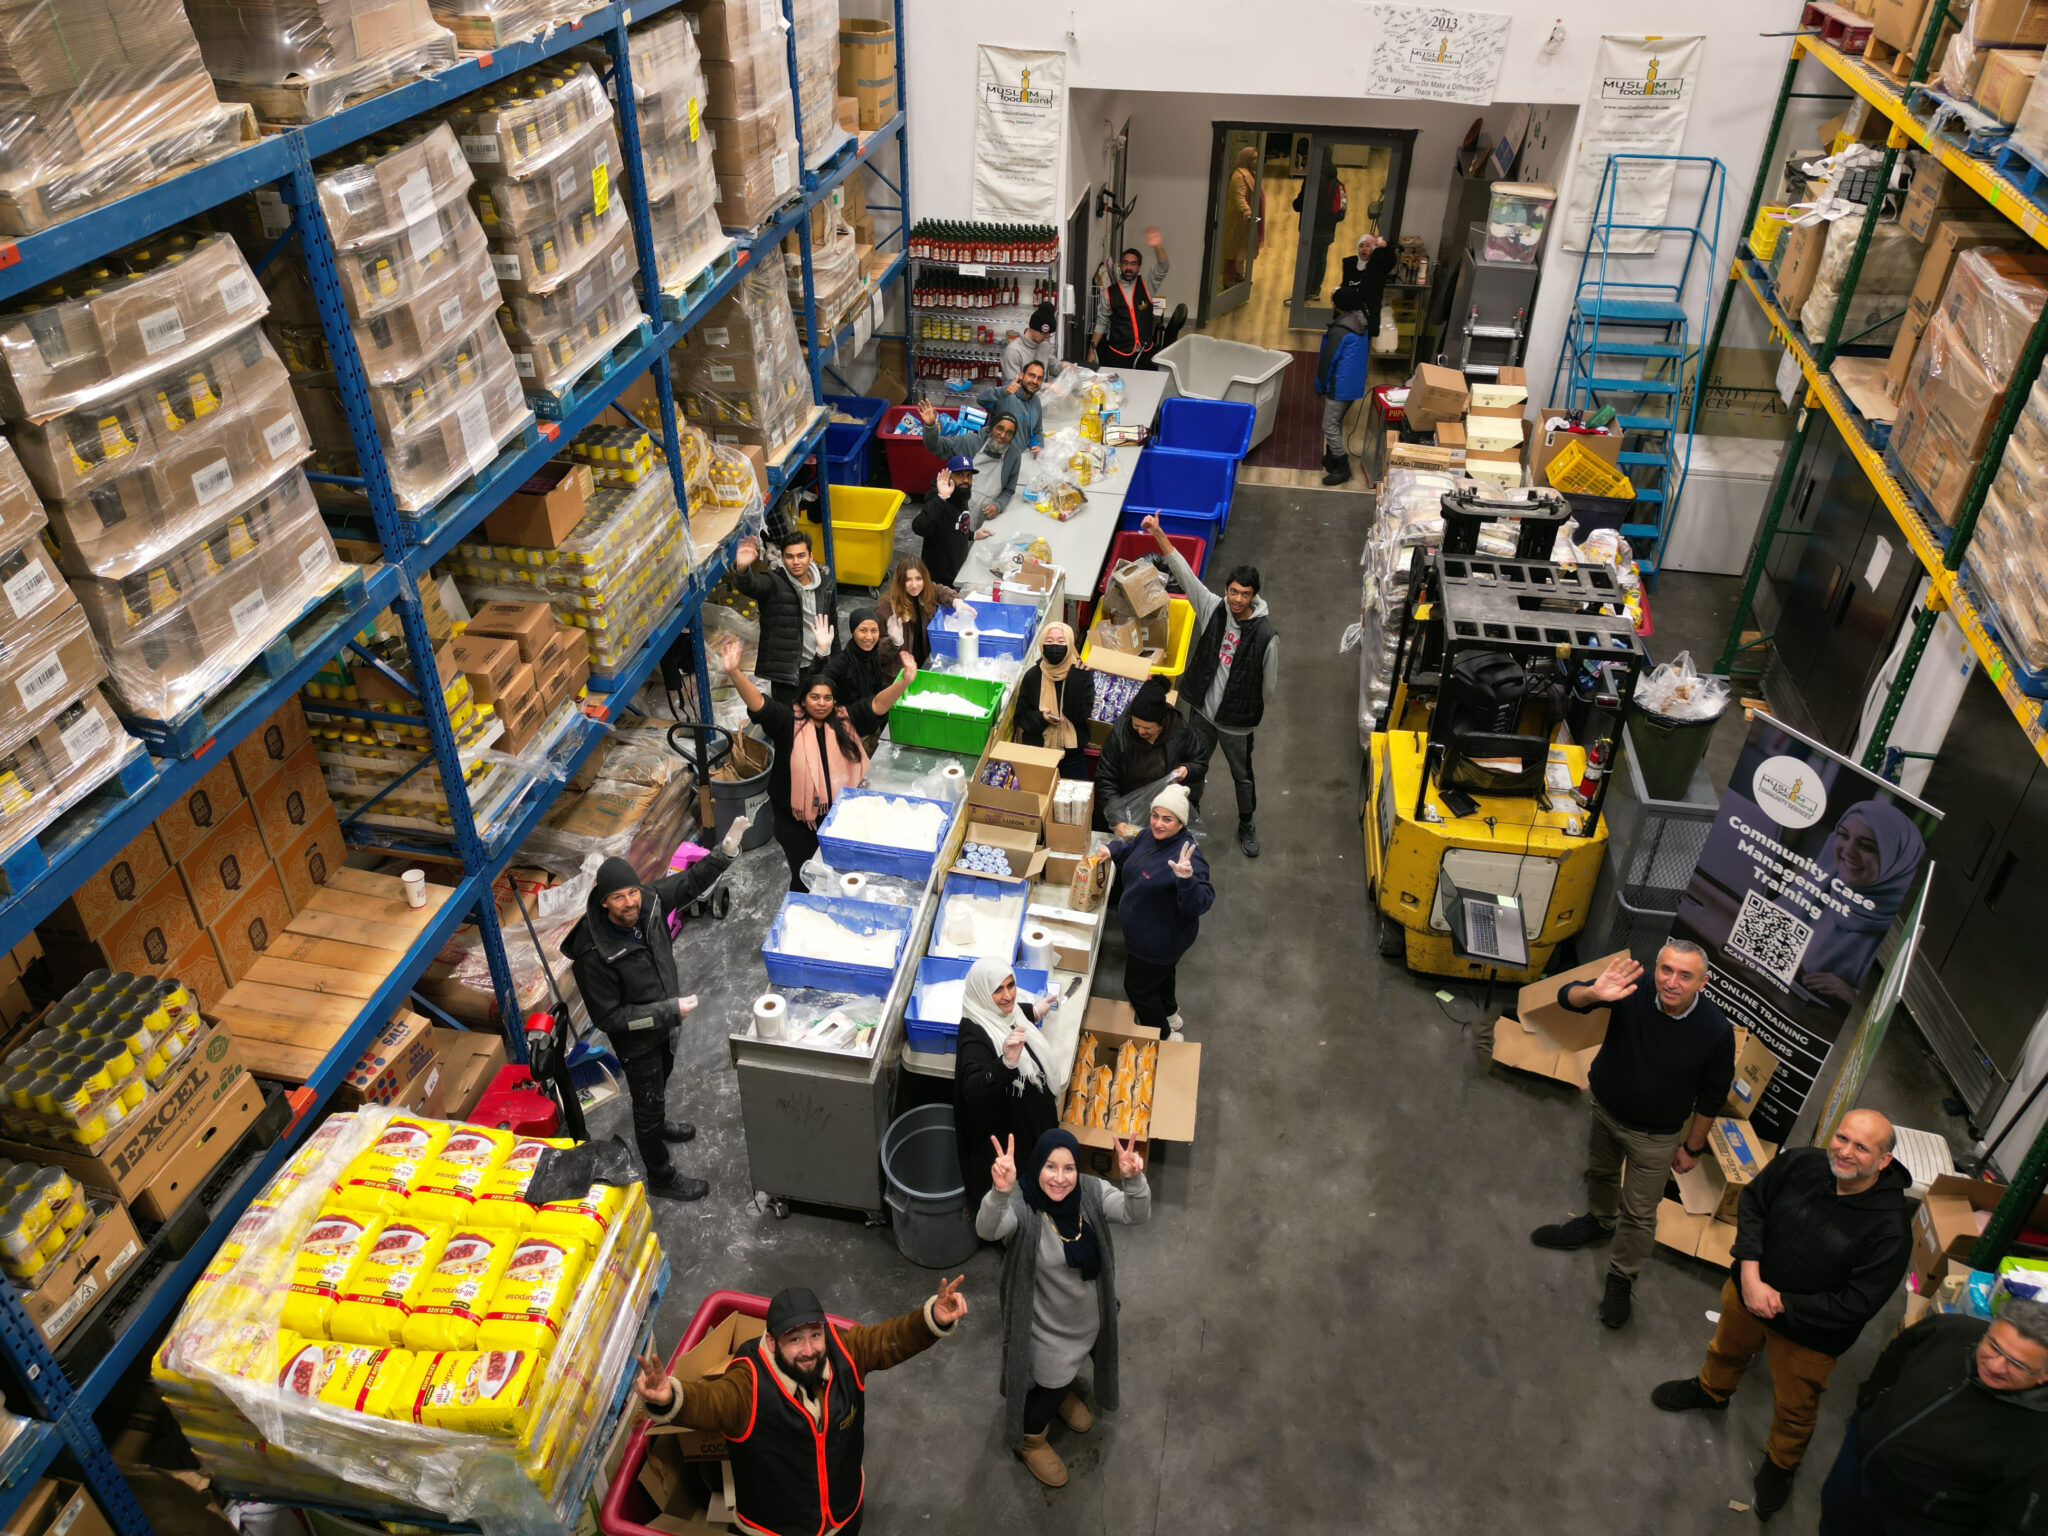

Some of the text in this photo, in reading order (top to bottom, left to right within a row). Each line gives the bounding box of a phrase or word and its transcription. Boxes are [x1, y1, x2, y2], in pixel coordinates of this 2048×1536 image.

[1431, 16, 1458, 30] 2013
[1390, 77, 1420, 87] Volunteers
[1431, 81, 1446, 89] Make
[1414, 88, 1444, 98] Thank You
[1390, 460, 1411, 468] BAKED
[1002, 817, 1025, 827] LUZON
[1728, 815, 1876, 911] Community Case
[1737, 839, 1851, 918] Management
[1753, 866, 1822, 920] Training
[1723, 945, 1790, 995] SCAN TO REGISTER
[1720, 979, 1759, 1009] ONLINE
[1760, 1006, 1809, 1046] TRAINING
[382, 1020, 409, 1046] SALT
[1756, 1028, 1793, 1057] HOURS
[119, 1067, 211, 1173] EXCEL
[1727, 1157, 1743, 1182] BAKED
[298, 1266, 342, 1278] all-purpose
[363, 1276, 407, 1288] all-purpose
[431, 1287, 475, 1297] all-purpose
[505, 1293, 548, 1304] all-purpose
[426, 1363, 437, 1378] SIZE
[364, 1374, 375, 1389] SIZE
[436, 1359, 459, 1403] all-purpose
